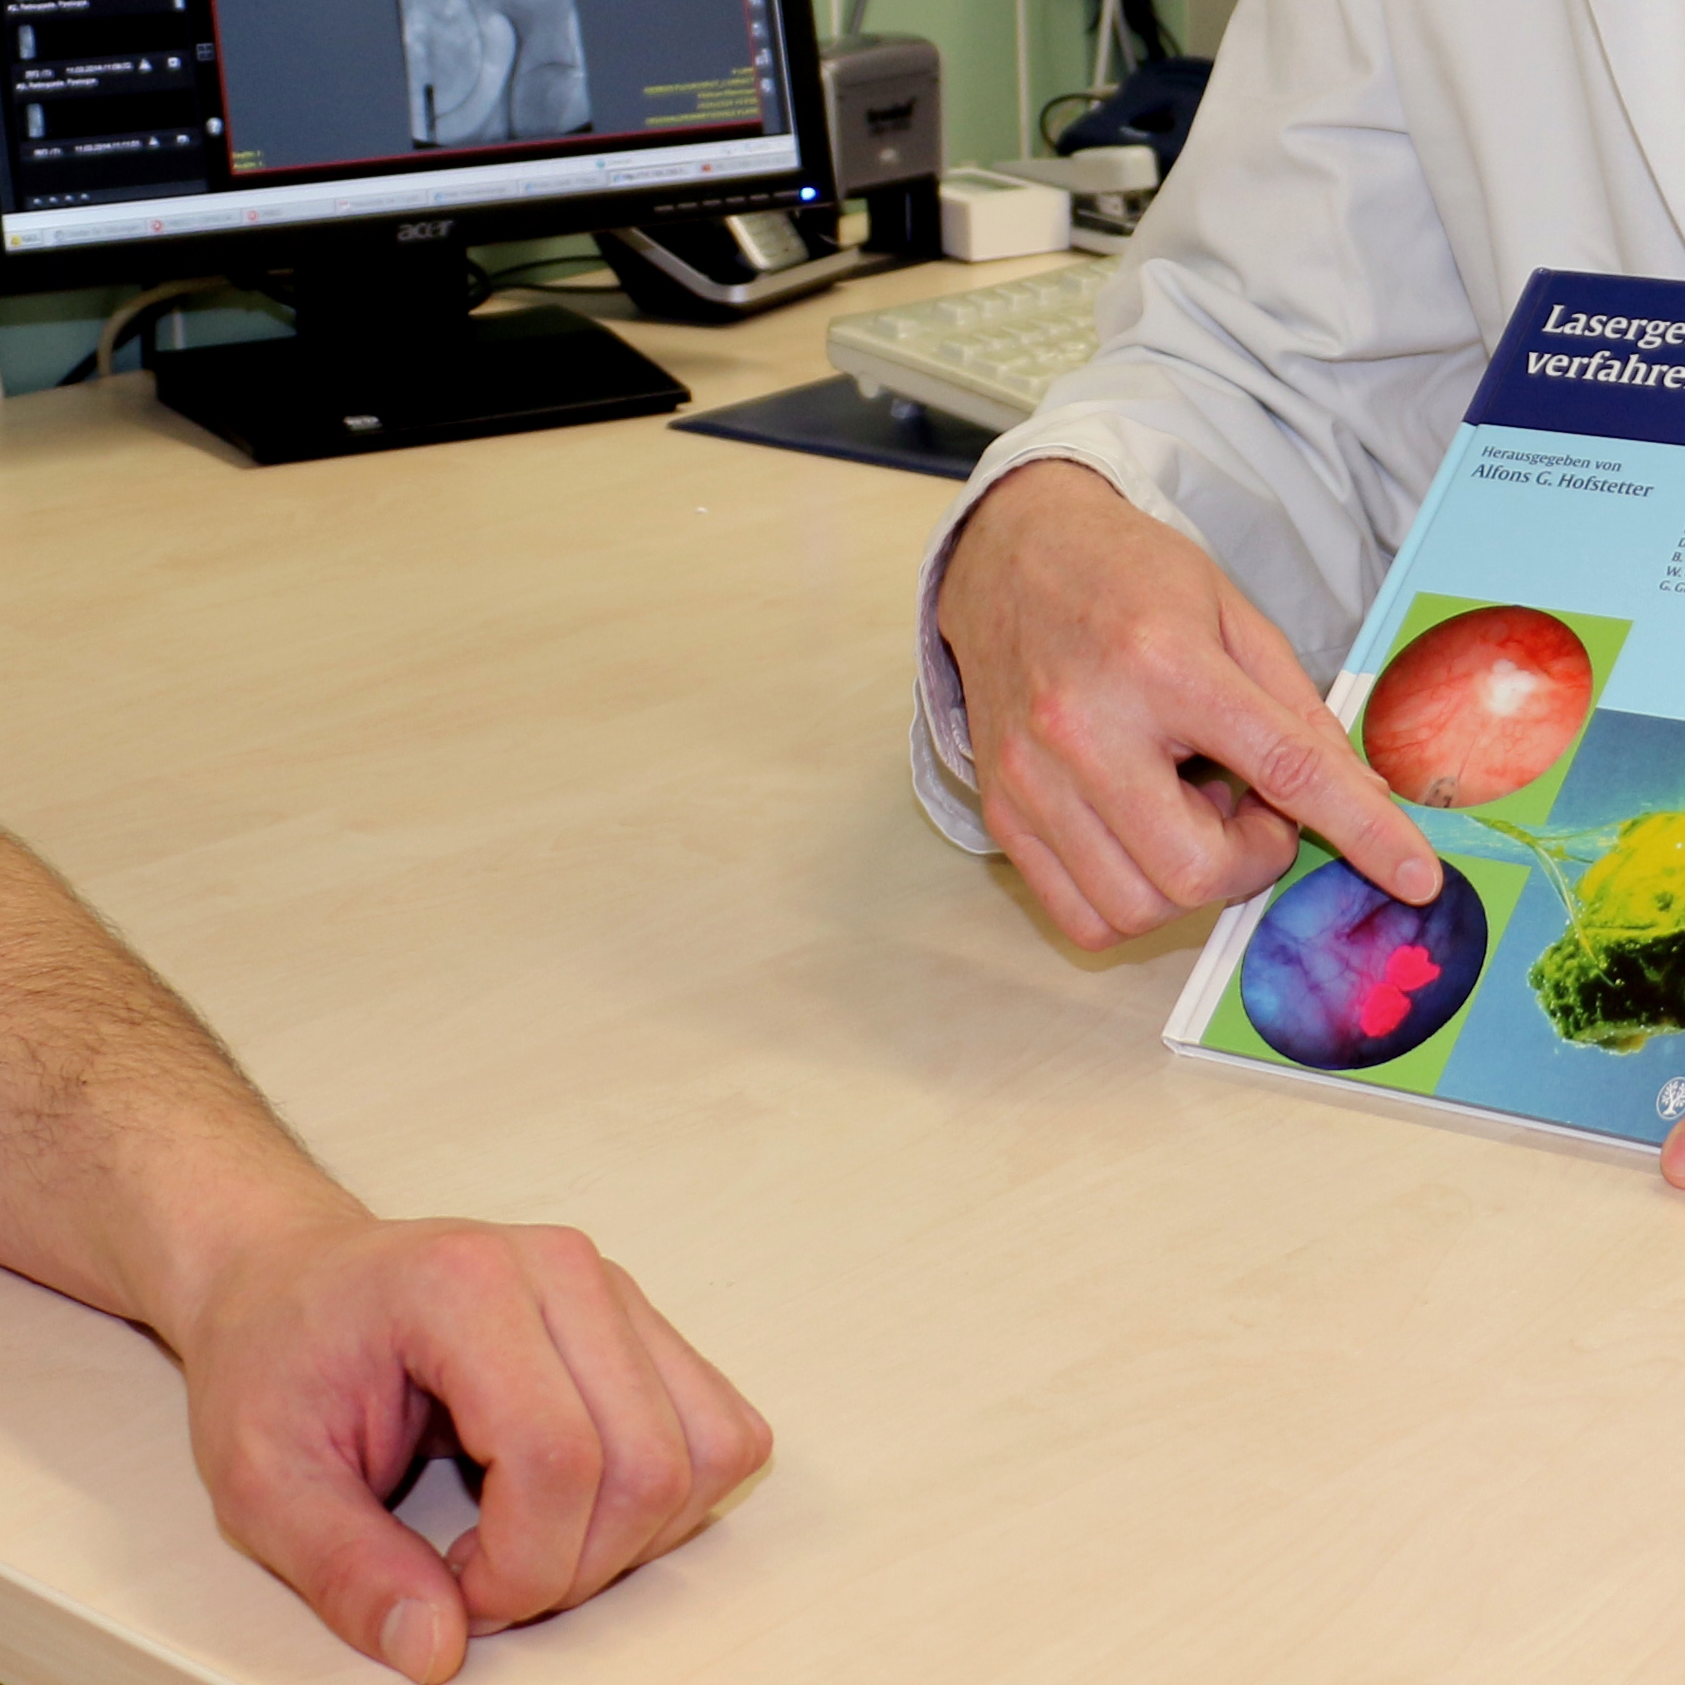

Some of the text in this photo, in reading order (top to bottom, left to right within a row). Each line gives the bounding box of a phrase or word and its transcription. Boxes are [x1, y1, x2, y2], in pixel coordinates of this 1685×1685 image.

[397, 219, 454, 242] acer
[1481, 445, 1622, 472] Herausgegeben von
[1471, 464, 1654, 498] Alfons G. Hofstetter
[1671, 551, 1683, 562] B.
[1666, 566, 1681, 578] W.
[1659, 580, 1671, 591] G.
